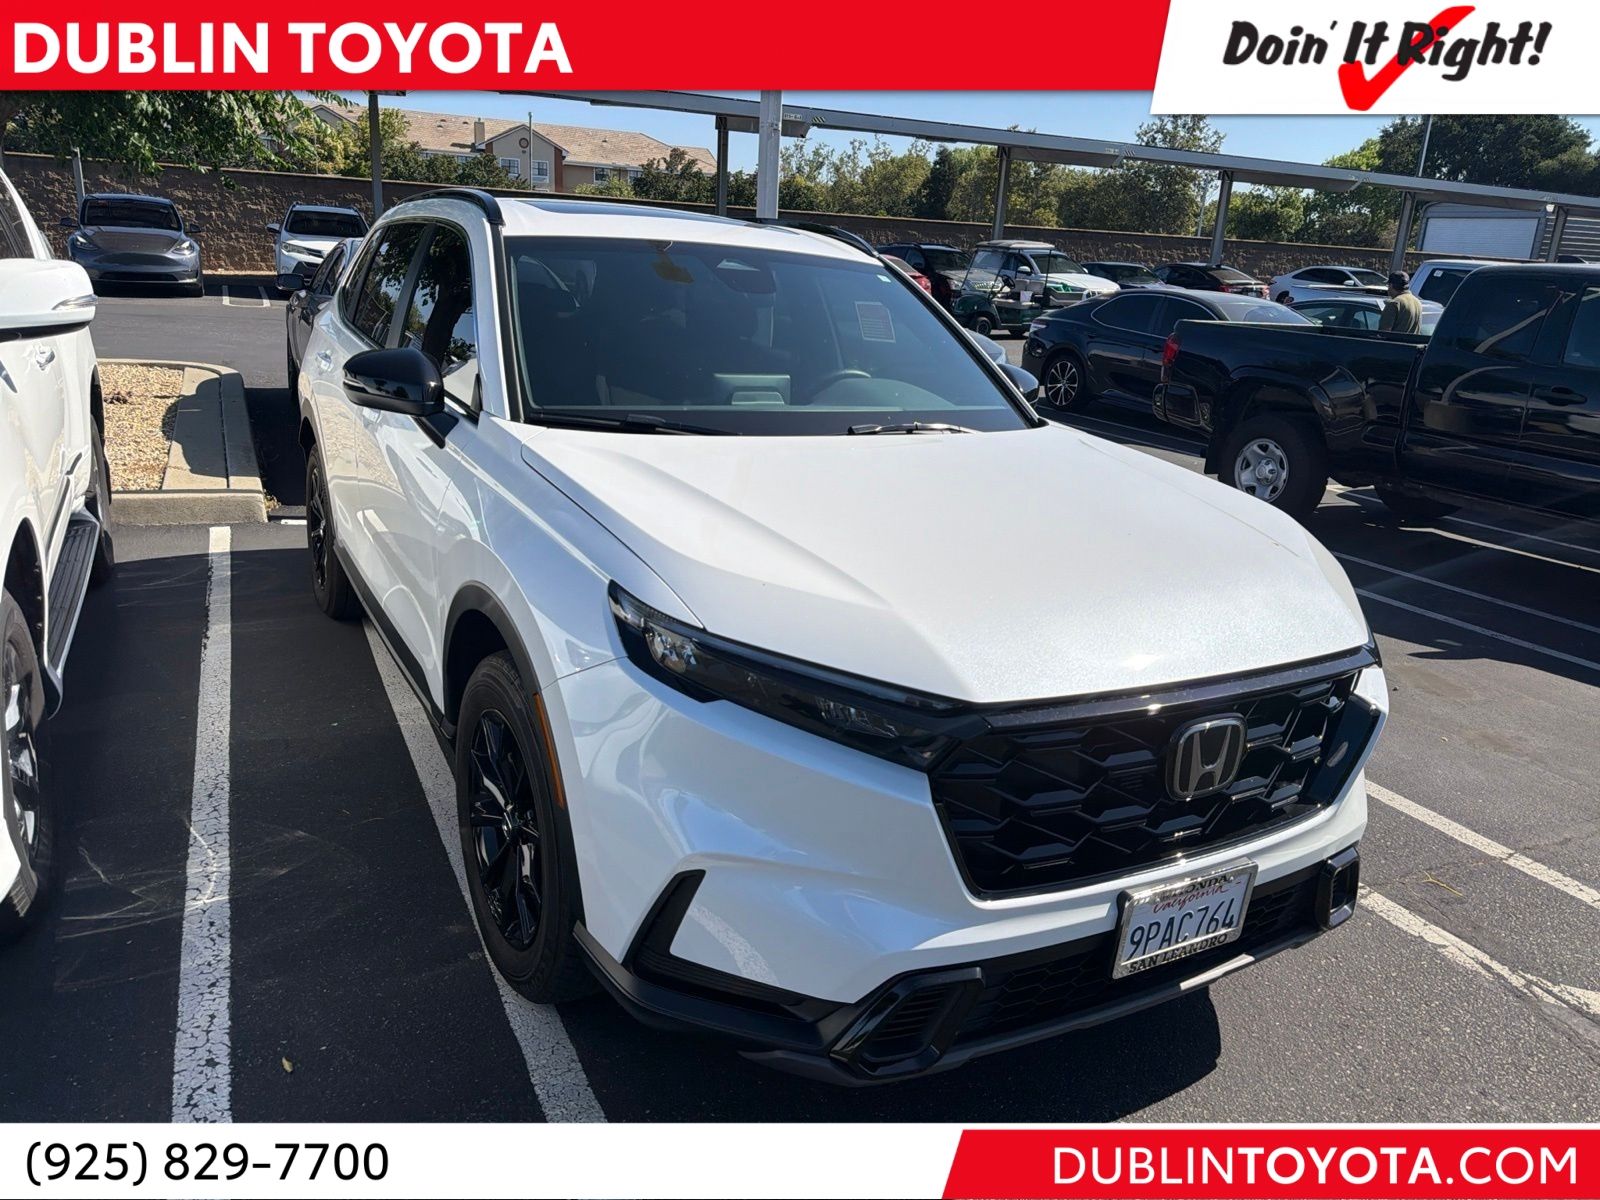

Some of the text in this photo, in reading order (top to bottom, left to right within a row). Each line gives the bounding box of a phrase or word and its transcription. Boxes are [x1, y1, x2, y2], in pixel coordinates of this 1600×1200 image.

[1127, 897, 1235, 961] 9PAC764
[1128, 933, 1228, 973] SAN LEANDRO
